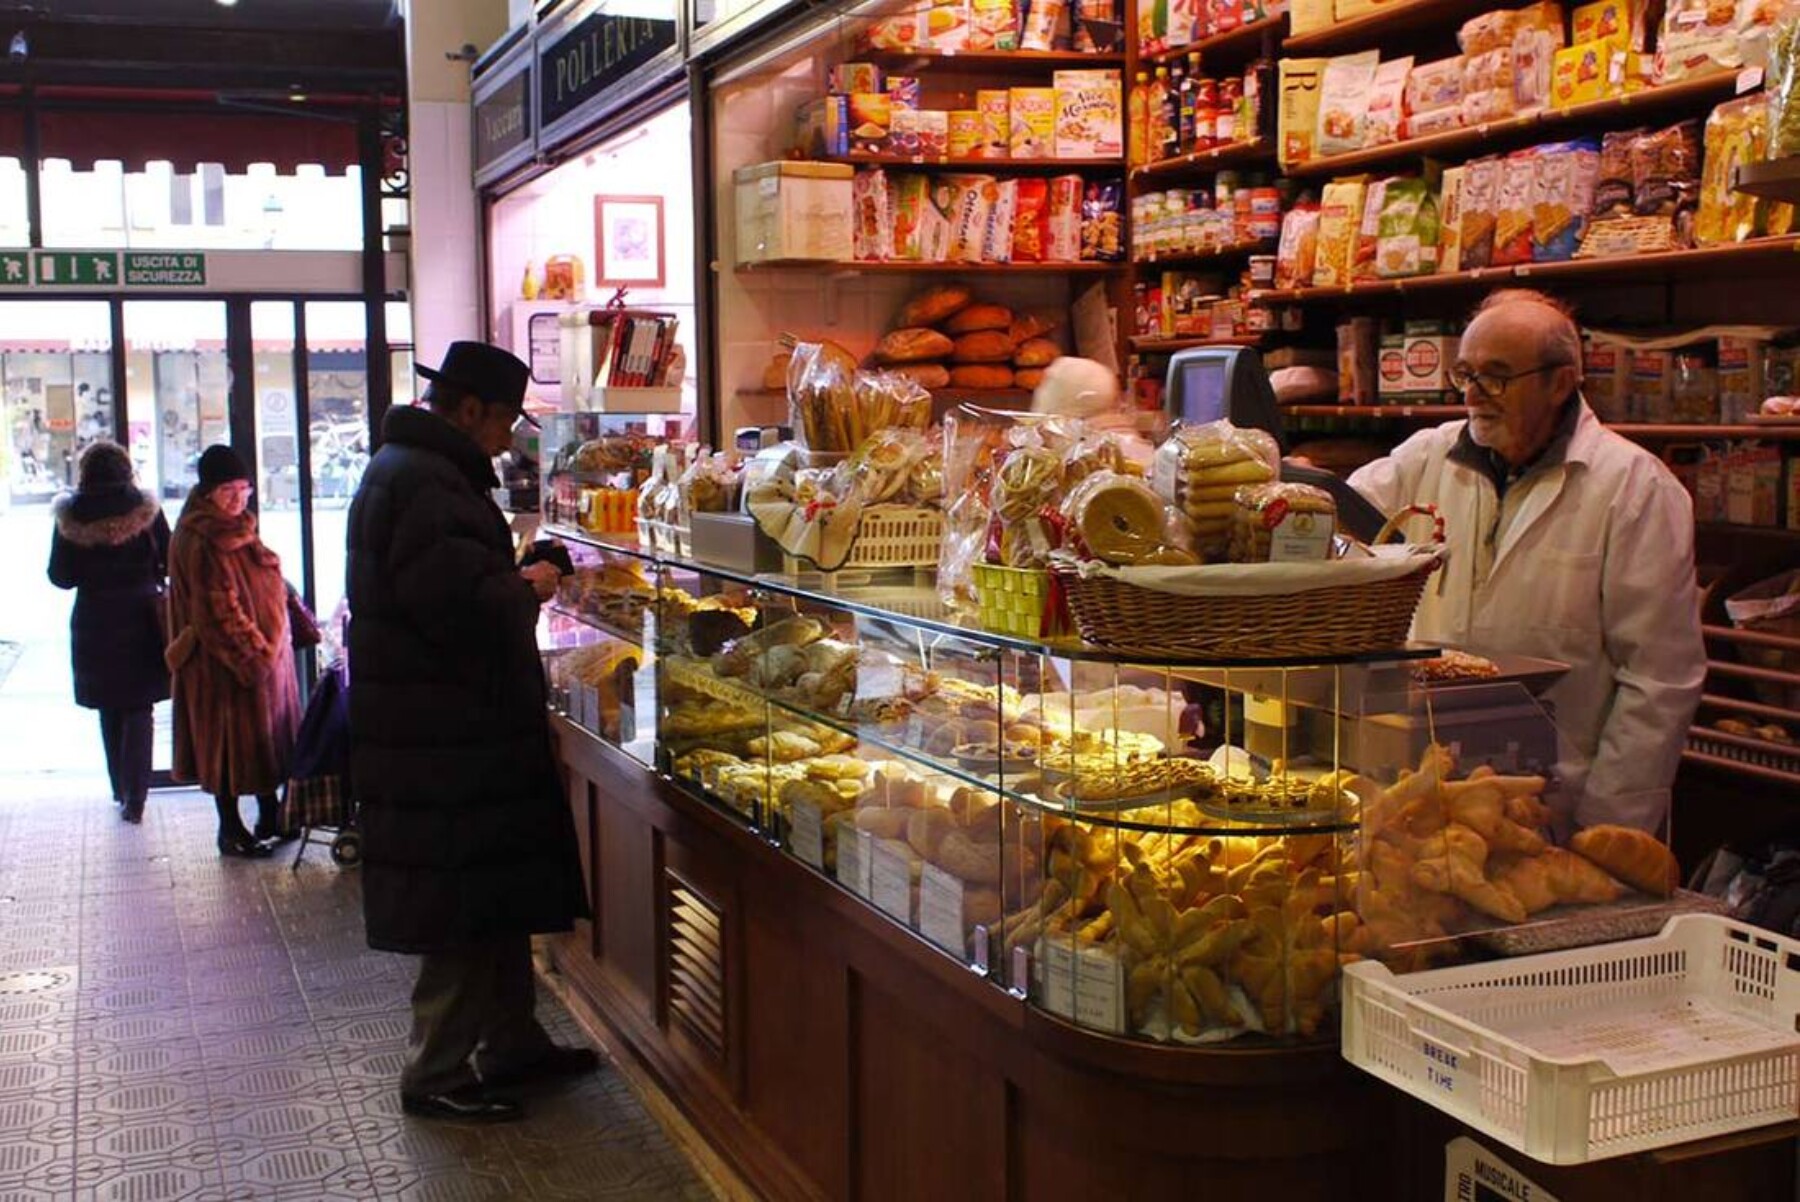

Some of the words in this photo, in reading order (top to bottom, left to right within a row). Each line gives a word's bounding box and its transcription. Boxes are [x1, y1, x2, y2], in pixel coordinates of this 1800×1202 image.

[132, 255, 180, 267] USCITA
[183, 255, 198, 267] DI
[128, 270, 202, 283] SICUREZZA
[1427, 1067, 1454, 1091] TIME
[1474, 1158, 1532, 1200] MUSICALE
